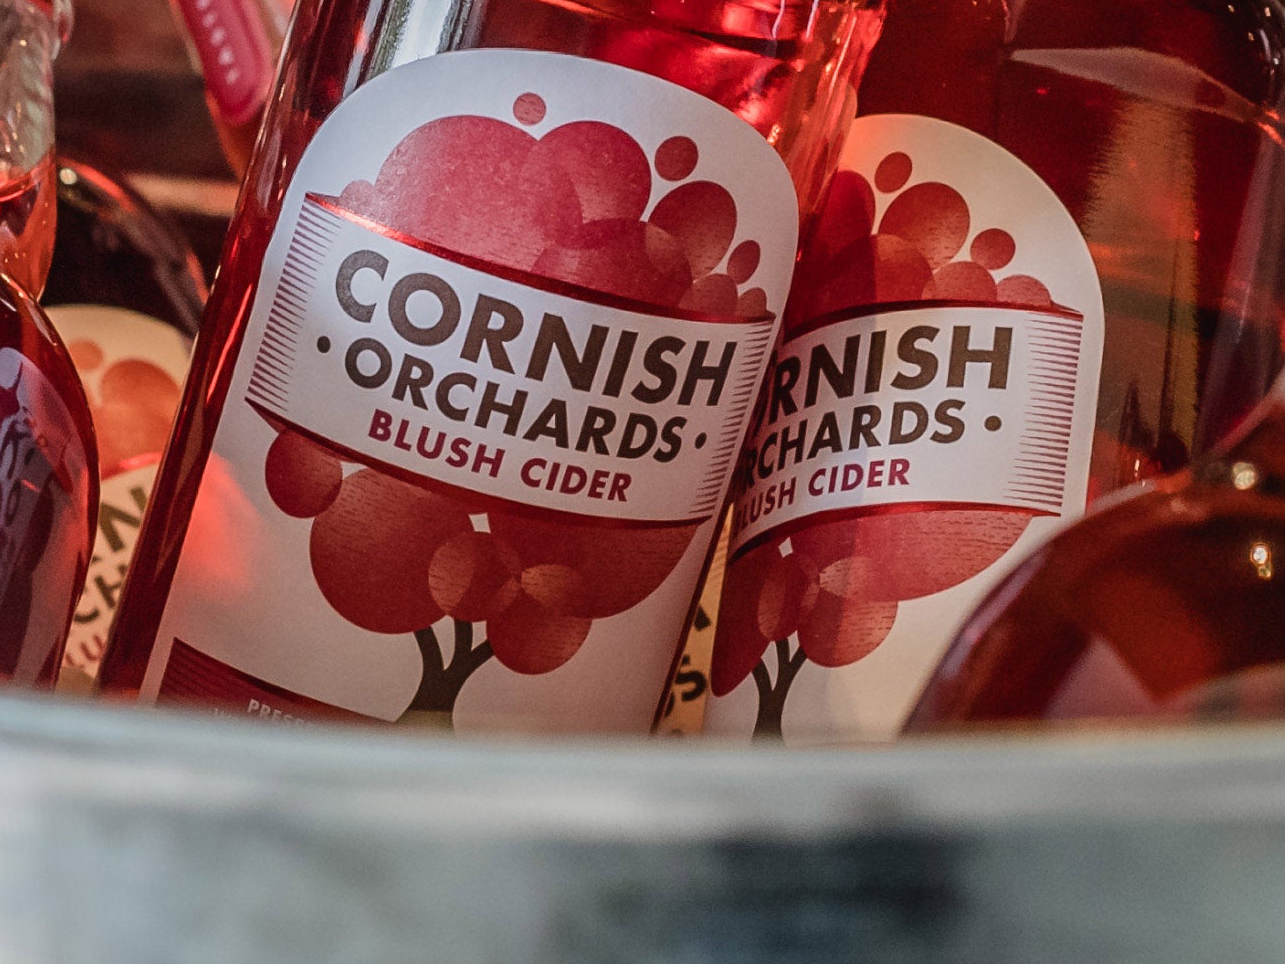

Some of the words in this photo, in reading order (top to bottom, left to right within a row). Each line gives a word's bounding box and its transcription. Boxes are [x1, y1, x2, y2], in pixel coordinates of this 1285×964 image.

[335, 249, 739, 407] CORNISH
[768, 325, 1014, 426] RNISH
[344, 336, 689, 464] ORCHARDS
[744, 399, 967, 488] RCHARDS
[368, 409, 506, 478] BLUSH
[520, 456, 633, 502] CIDER
[808, 457, 911, 497] CIDER
